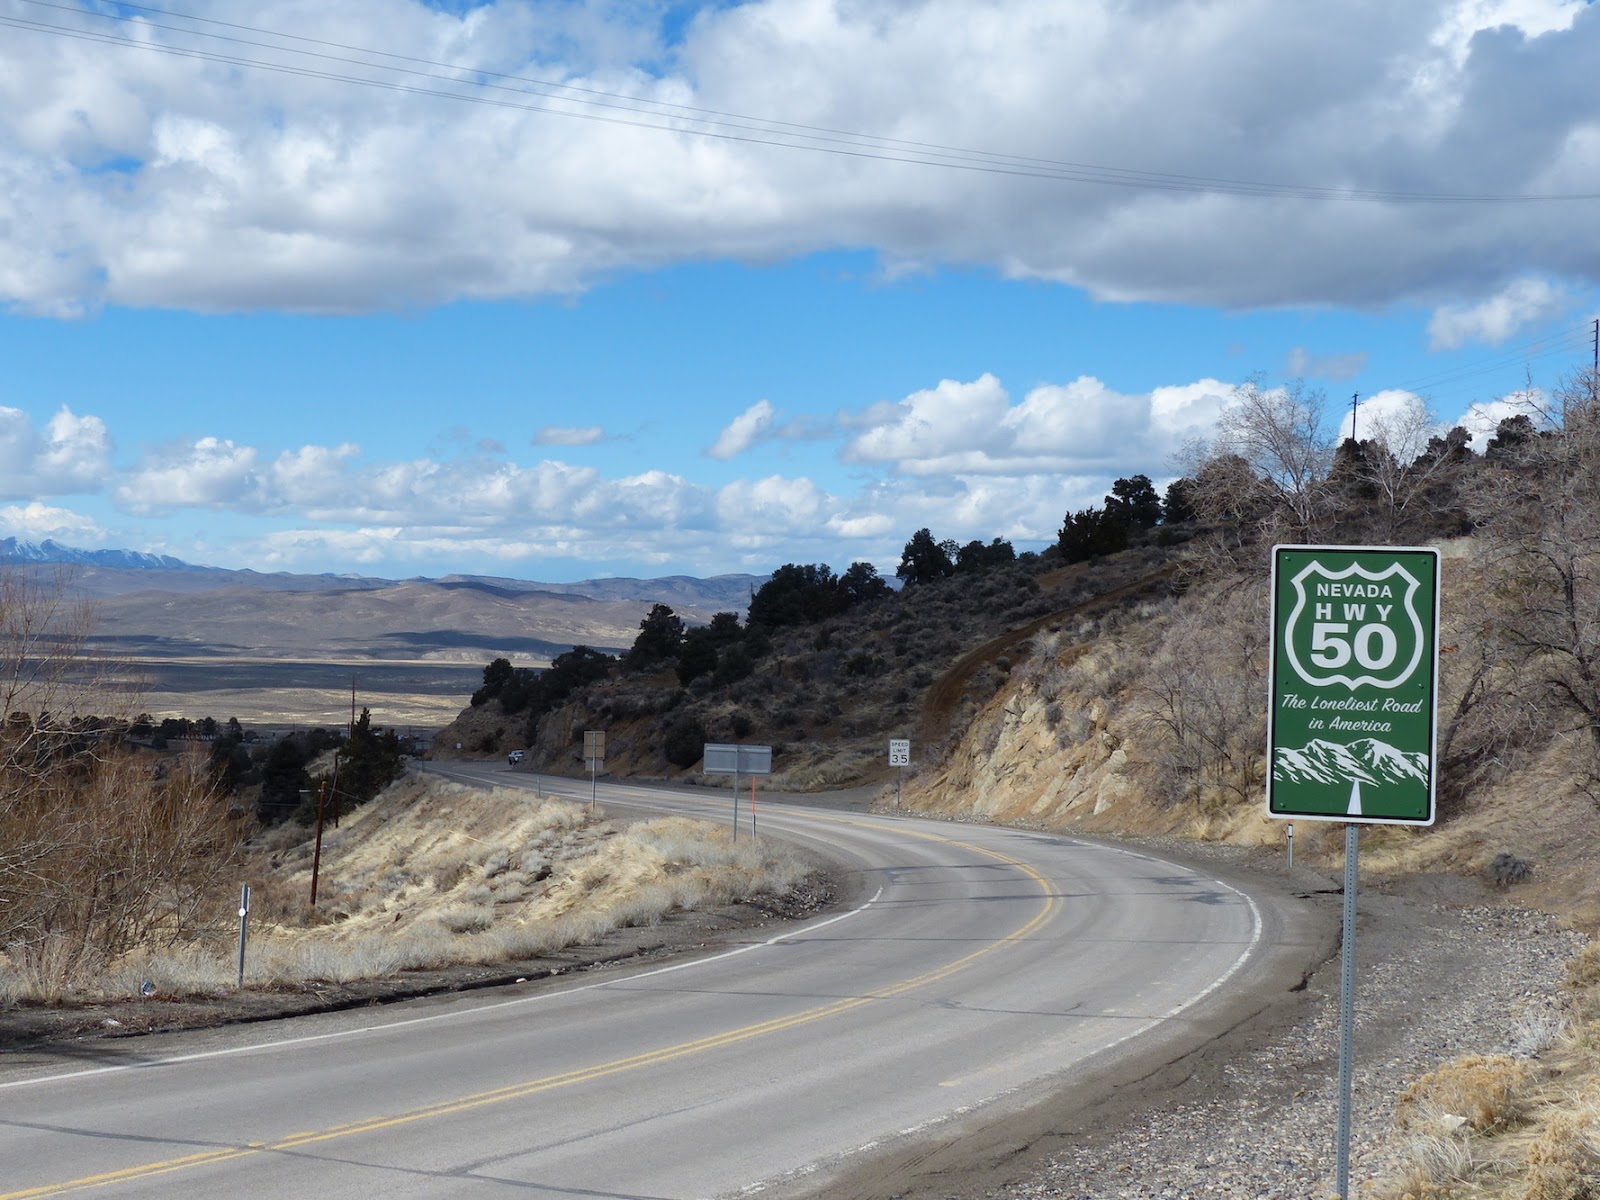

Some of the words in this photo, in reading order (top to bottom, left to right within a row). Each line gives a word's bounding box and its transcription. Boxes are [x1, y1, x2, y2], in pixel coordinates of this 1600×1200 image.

[1317, 583, 1393, 598] NEVADA
[1310, 622, 1397, 670] 50
[1281, 694, 1307, 709] The
[1311, 696, 1378, 712] Loneliest
[1381, 697, 1424, 713] Road
[1308, 717, 1325, 730] in
[1328, 716, 1392, 732] America
[891, 754, 908, 763] 35
